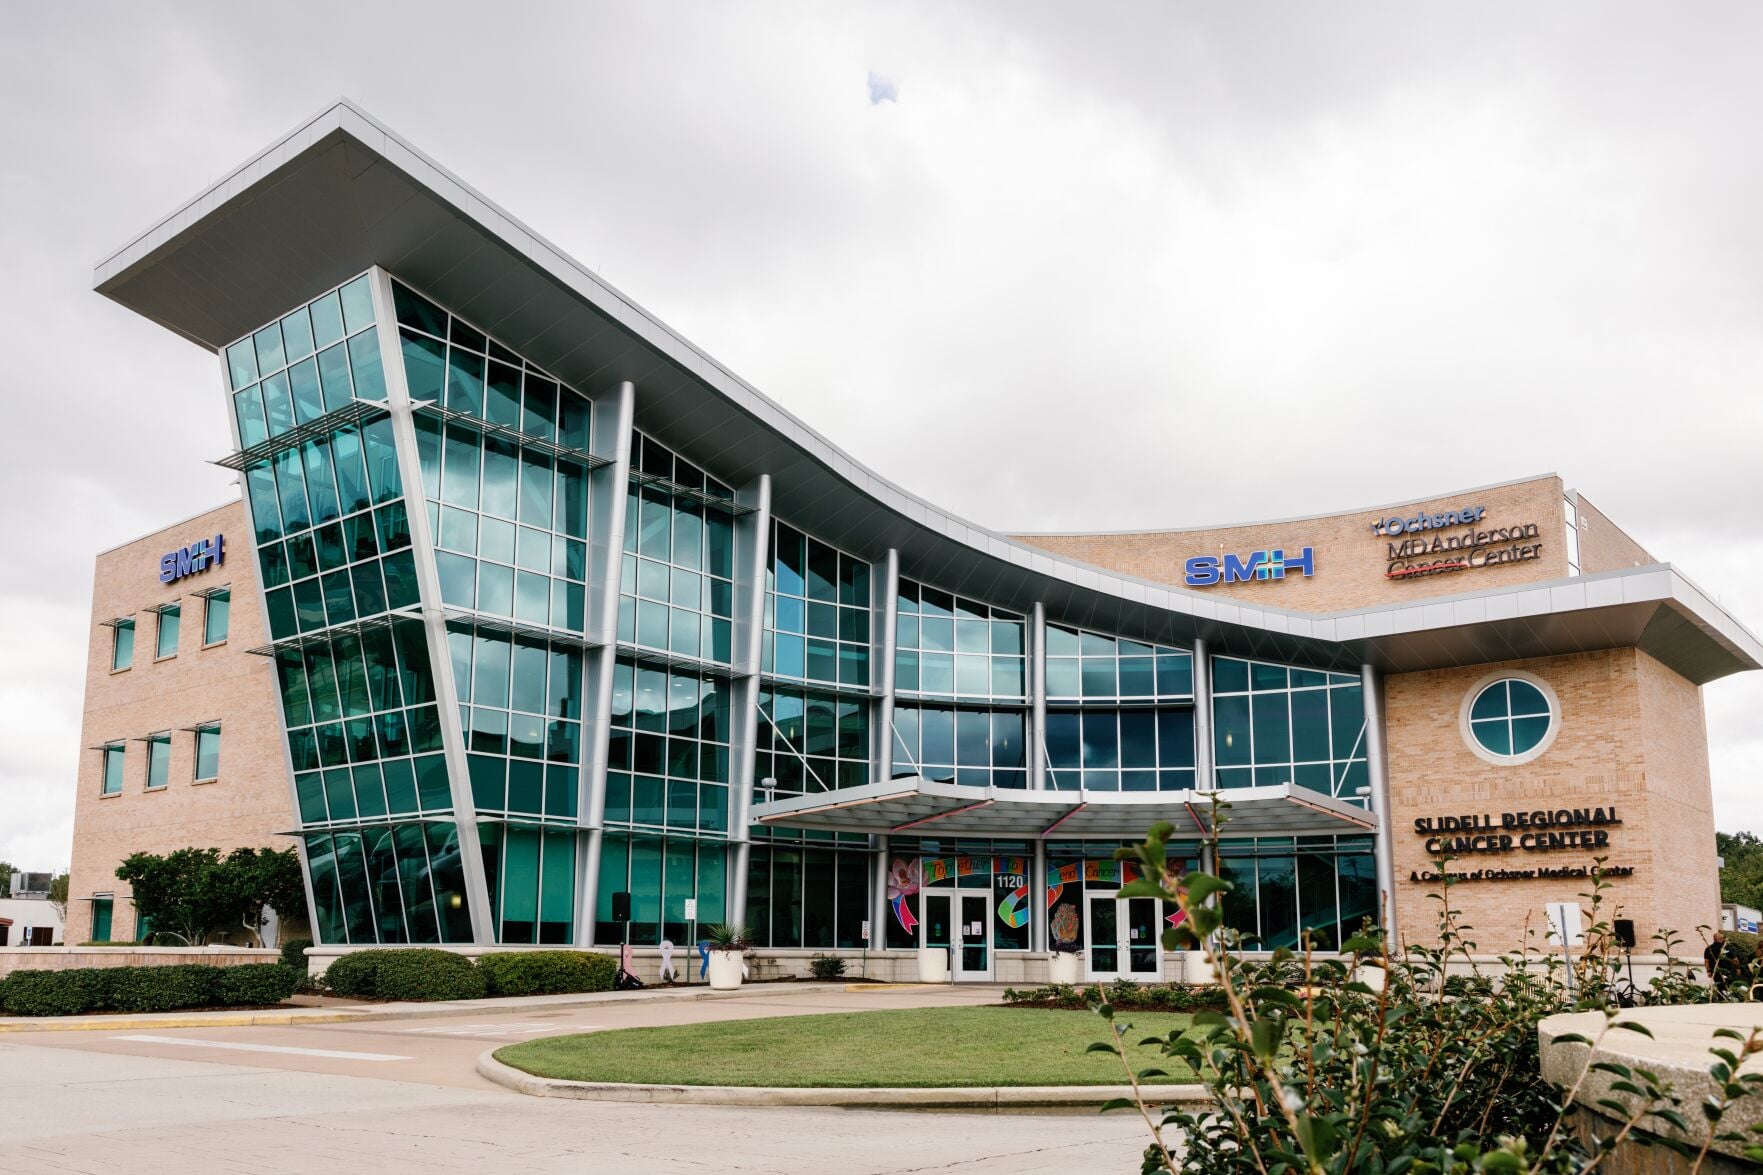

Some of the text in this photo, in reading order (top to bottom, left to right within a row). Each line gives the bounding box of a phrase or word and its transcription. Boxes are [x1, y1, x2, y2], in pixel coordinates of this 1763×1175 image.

[1384, 506, 1485, 537] Ochsner
[1386, 522, 1540, 561] MD Anderson
[159, 533, 224, 584] SMH
[1185, 547, 1314, 585] SMH
[1386, 543, 1543, 580] Cancer Center
[1414, 807, 1623, 835] SLIDELL REGIONAL
[1520, 830, 1610, 851] CENTER
[930, 857, 1121, 880] Together to end Cancer
[997, 876, 1023, 888] 1120
[1410, 871, 1420, 881] A
[1470, 869, 1484, 880] of
[1485, 868, 1535, 880] Ochsner
[1538, 866, 1587, 878] Medical
[1590, 866, 1635, 877] Cnter
